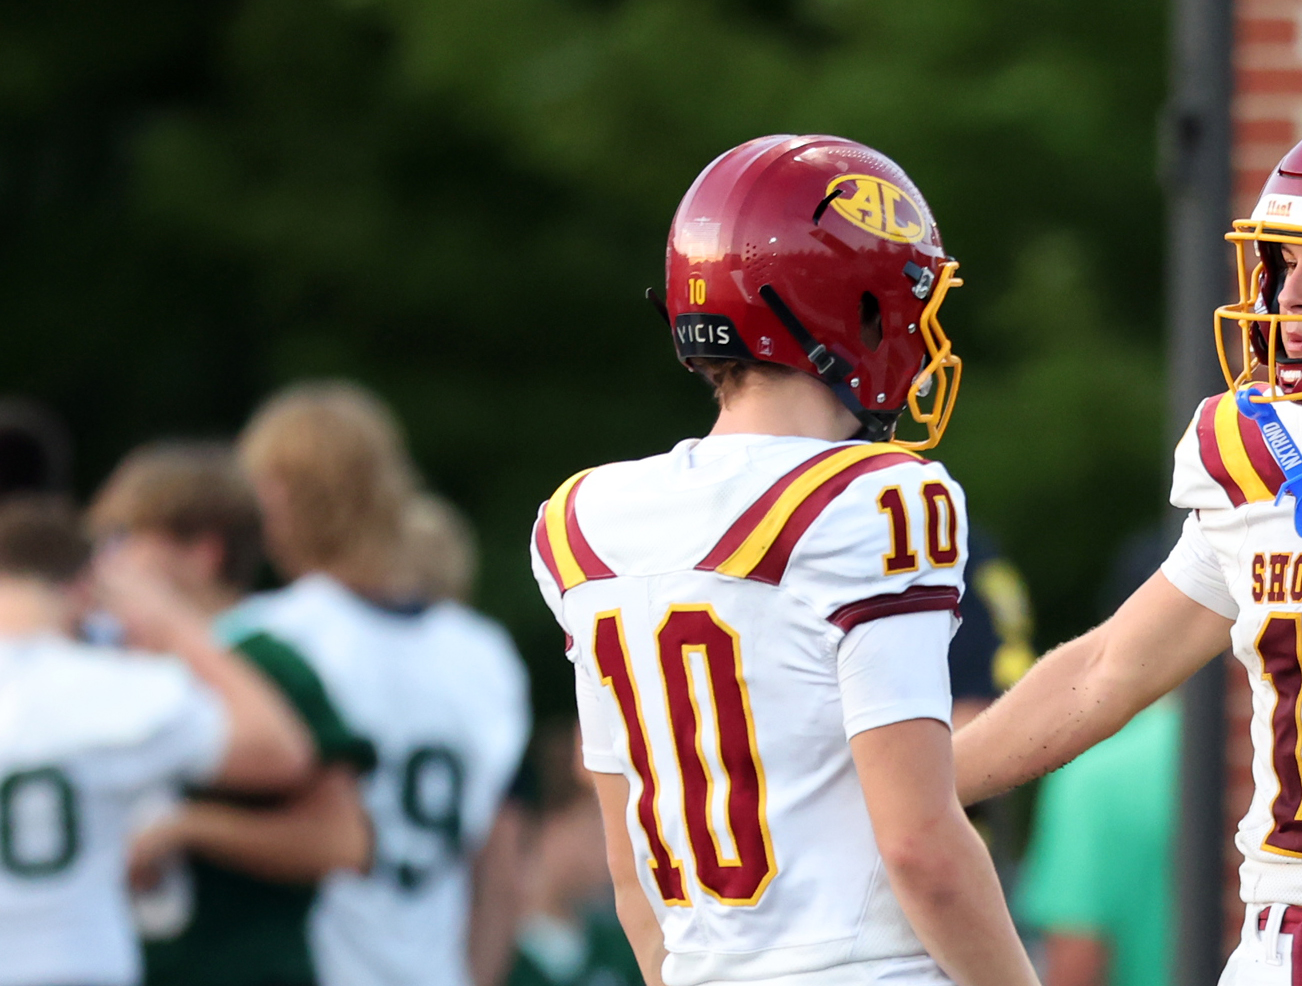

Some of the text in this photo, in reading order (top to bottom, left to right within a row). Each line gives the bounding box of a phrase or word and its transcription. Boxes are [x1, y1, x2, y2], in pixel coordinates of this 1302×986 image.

[688, 278, 707, 306] 10
[676, 323, 731, 345] VICIS
[1262, 421, 1302, 471] NXTRND
[874, 479, 960, 577] 10
[591, 602, 779, 908] 10
